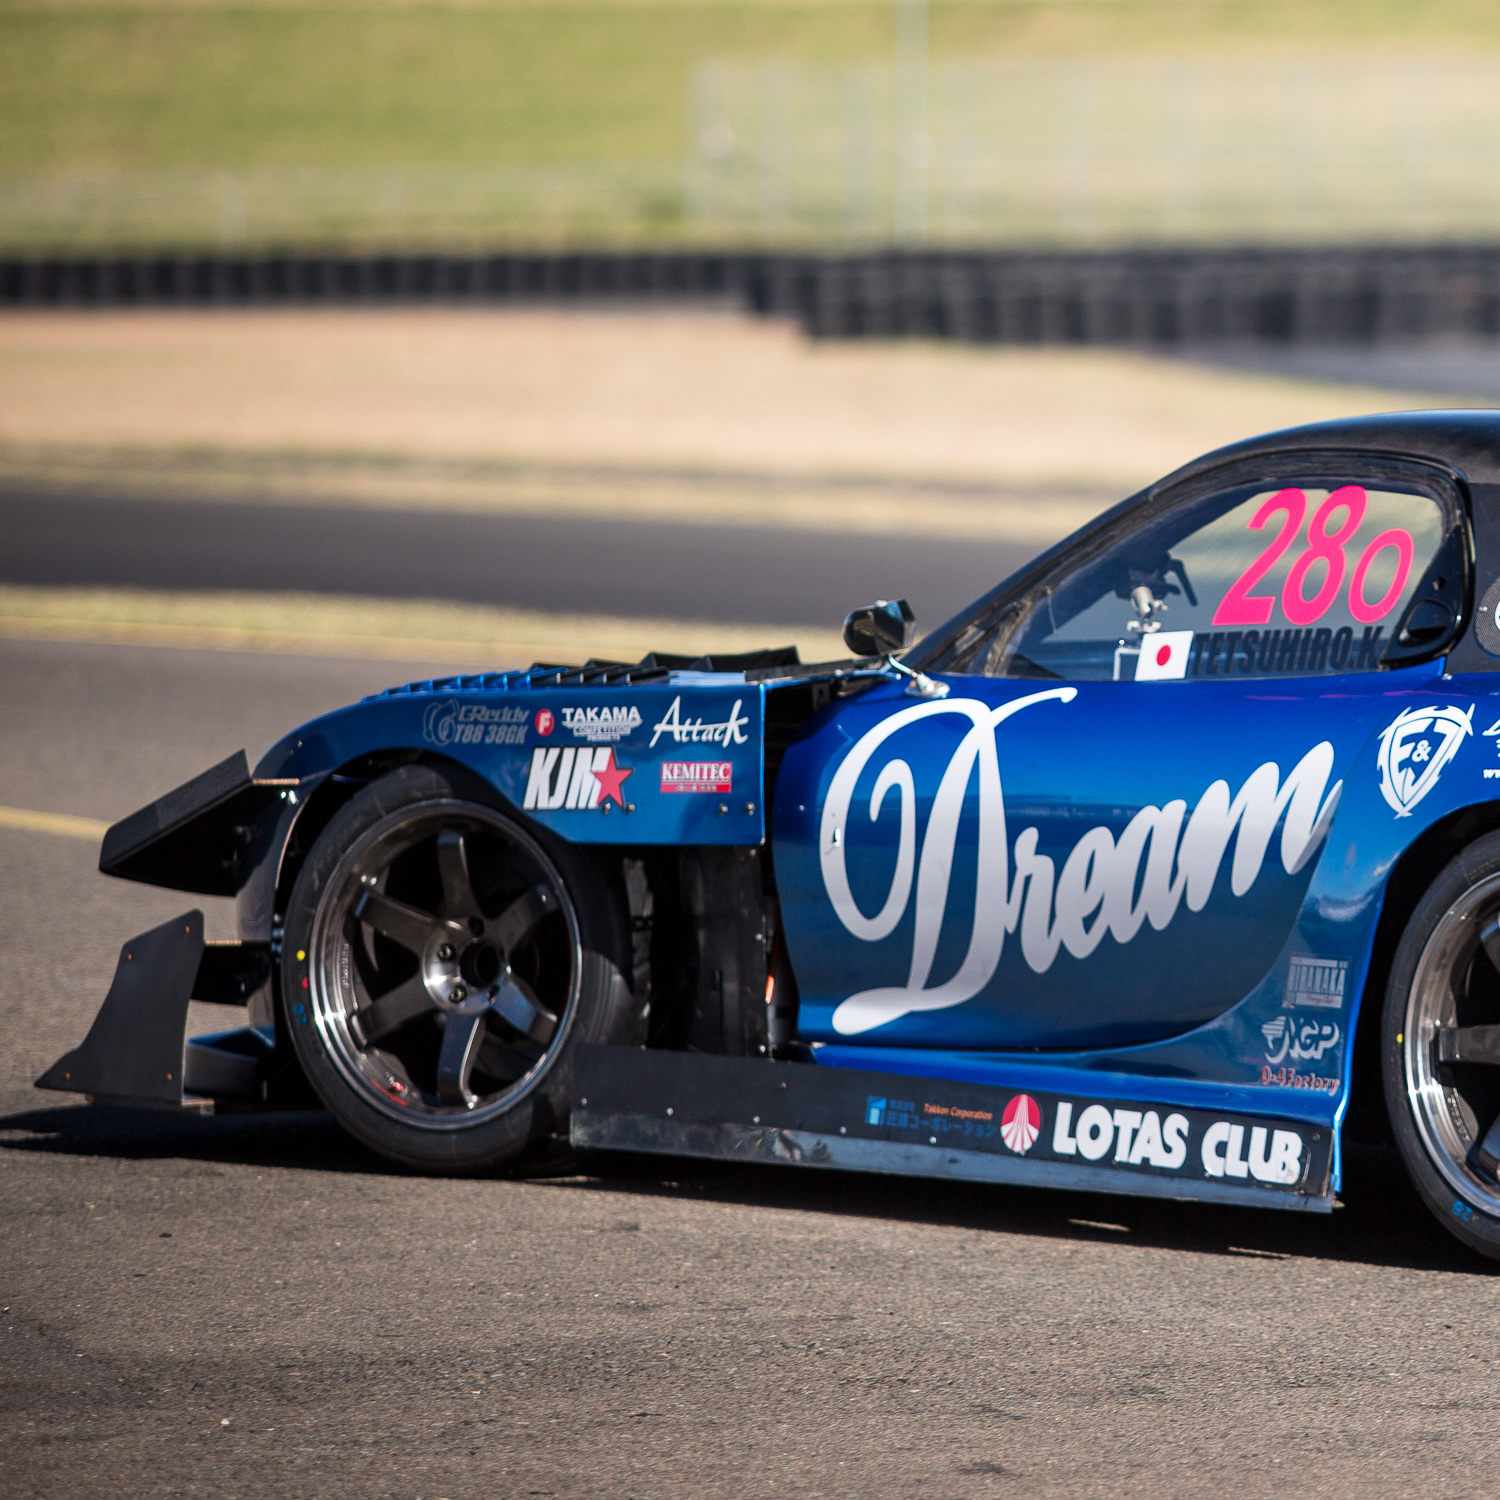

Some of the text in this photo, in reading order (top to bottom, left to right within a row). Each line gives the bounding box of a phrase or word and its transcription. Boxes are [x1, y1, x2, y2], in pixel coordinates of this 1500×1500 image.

[1211, 485, 1415, 626] 280
[1190, 626, 1385, 675] TETSUHIRO.K
[561, 706, 642, 722] TAKAMA
[649, 696, 749, 748] Attack
[522, 746, 612, 810] KJM
[662, 763, 731, 782] KEMITEC
[820, 687, 1343, 1035] Dream
[950, 1106, 993, 1120] Corporation
[1052, 1101, 1302, 1185] LOTAS CLUB
